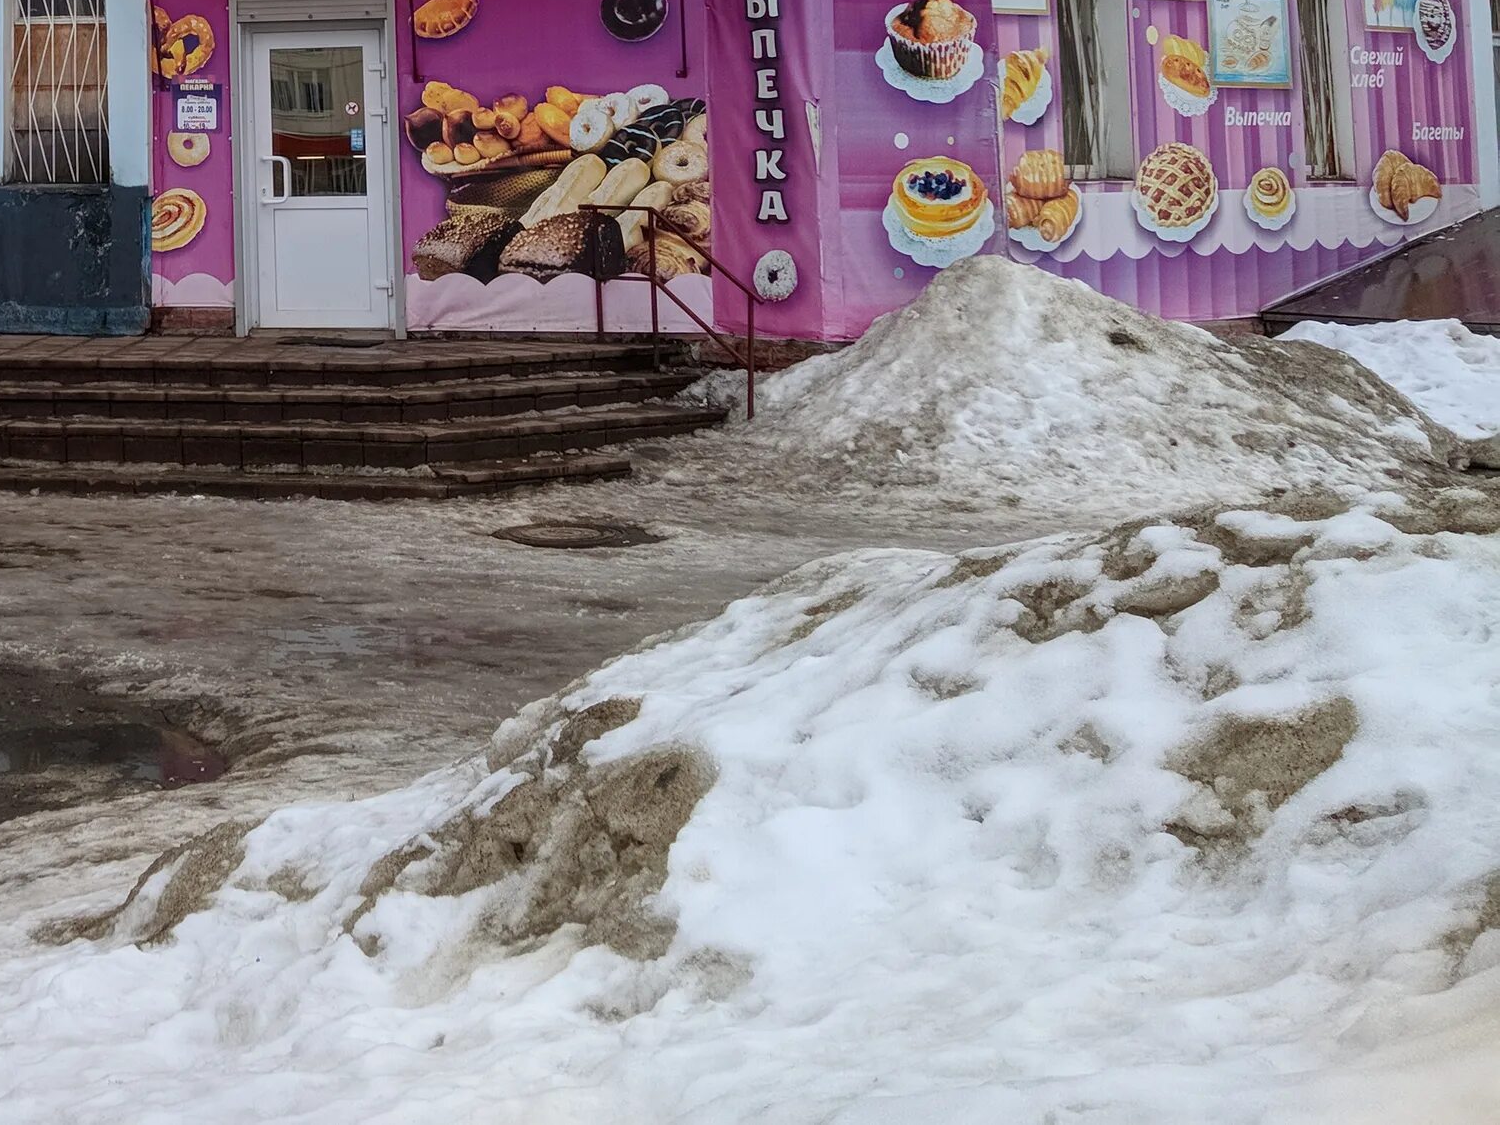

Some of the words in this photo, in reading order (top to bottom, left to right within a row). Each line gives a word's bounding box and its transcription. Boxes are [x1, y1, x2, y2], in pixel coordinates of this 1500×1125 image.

[1350, 45, 1404, 66] Свежий
[1351, 69, 1385, 88] хлеб
[1225, 106, 1291, 127] Выпечка
[1412, 121, 1464, 141] Багеты
